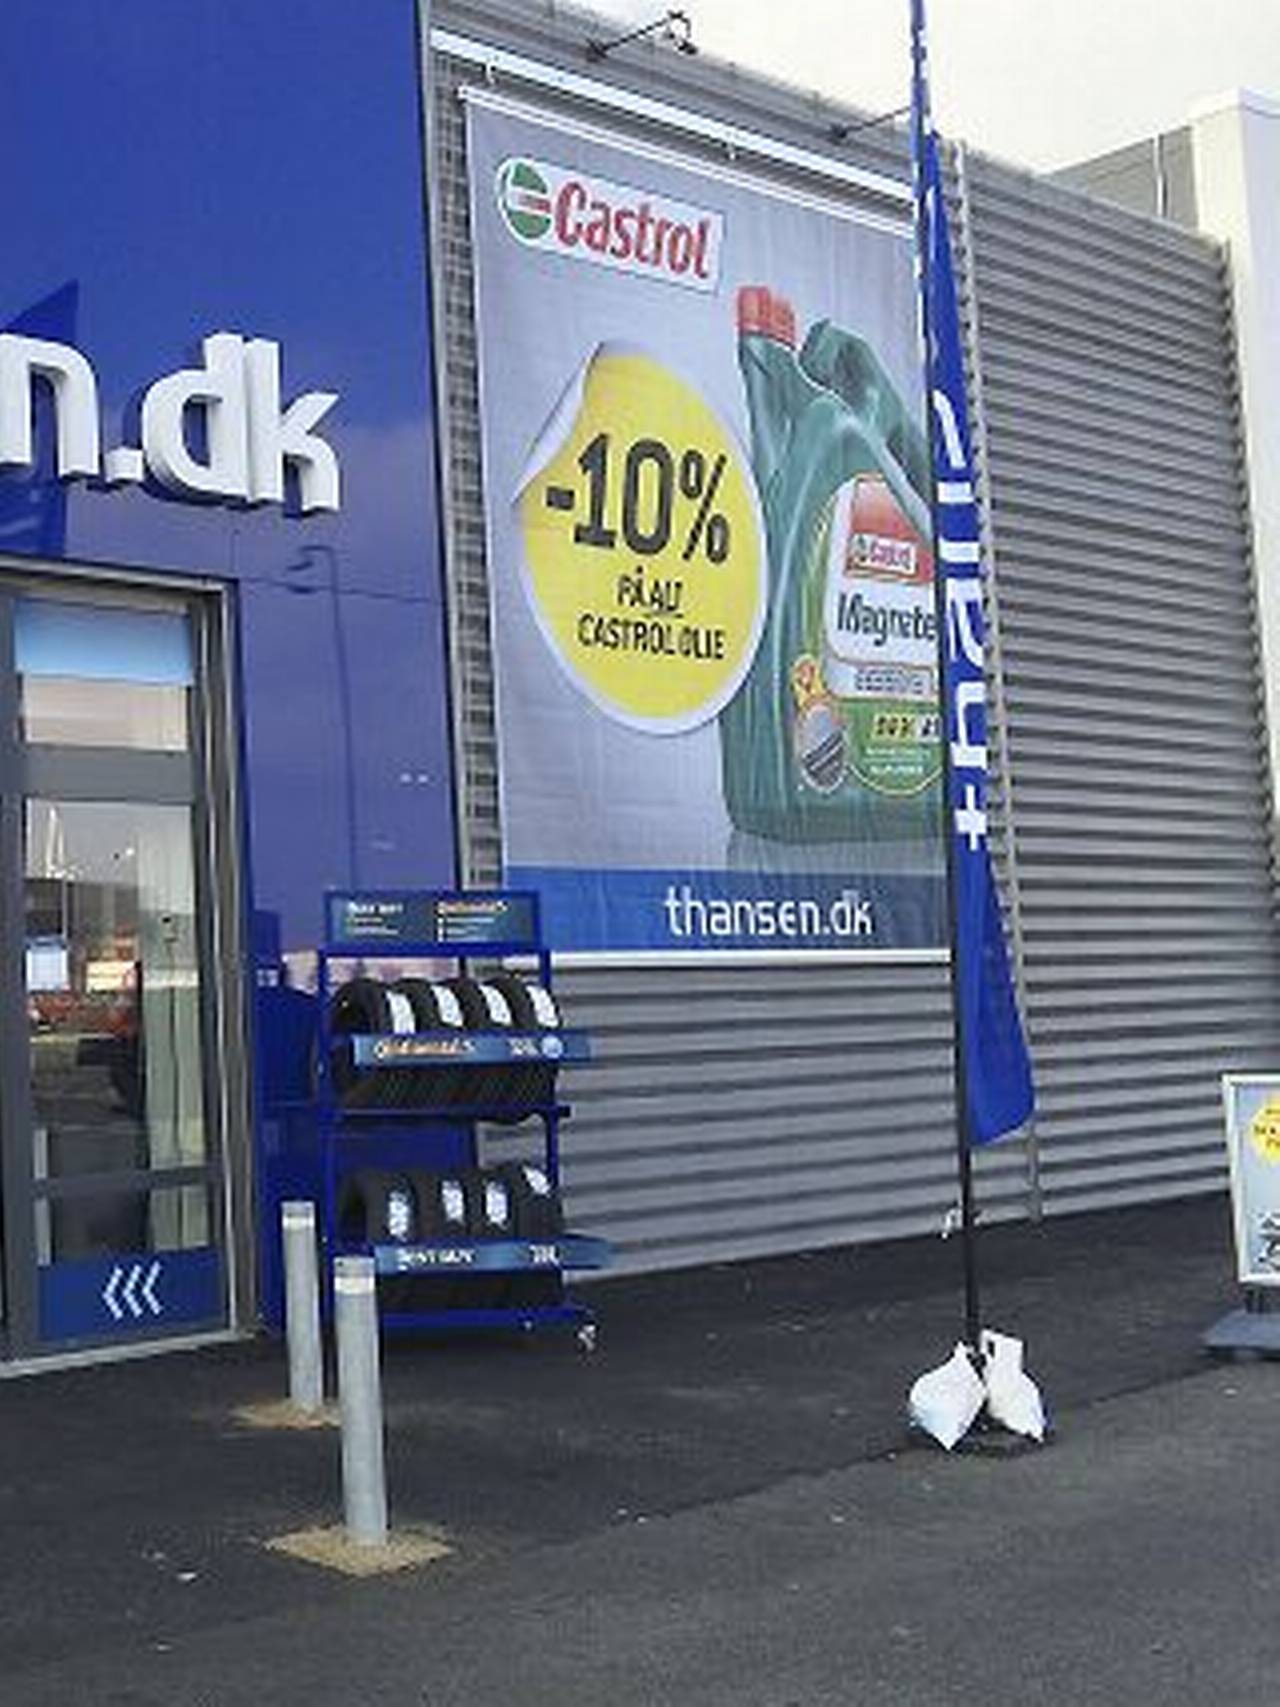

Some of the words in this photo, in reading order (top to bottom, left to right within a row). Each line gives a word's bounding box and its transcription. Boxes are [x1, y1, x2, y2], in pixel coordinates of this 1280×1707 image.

[555, 181, 711, 279] Castrol
[546, 432, 730, 564] -10%
[618, 565, 646, 606] PÅ
[578, 613, 675, 655] CASTROL
[678, 626, 725, 660] OLIE
[664, 885, 872, 936] thansen.dk
